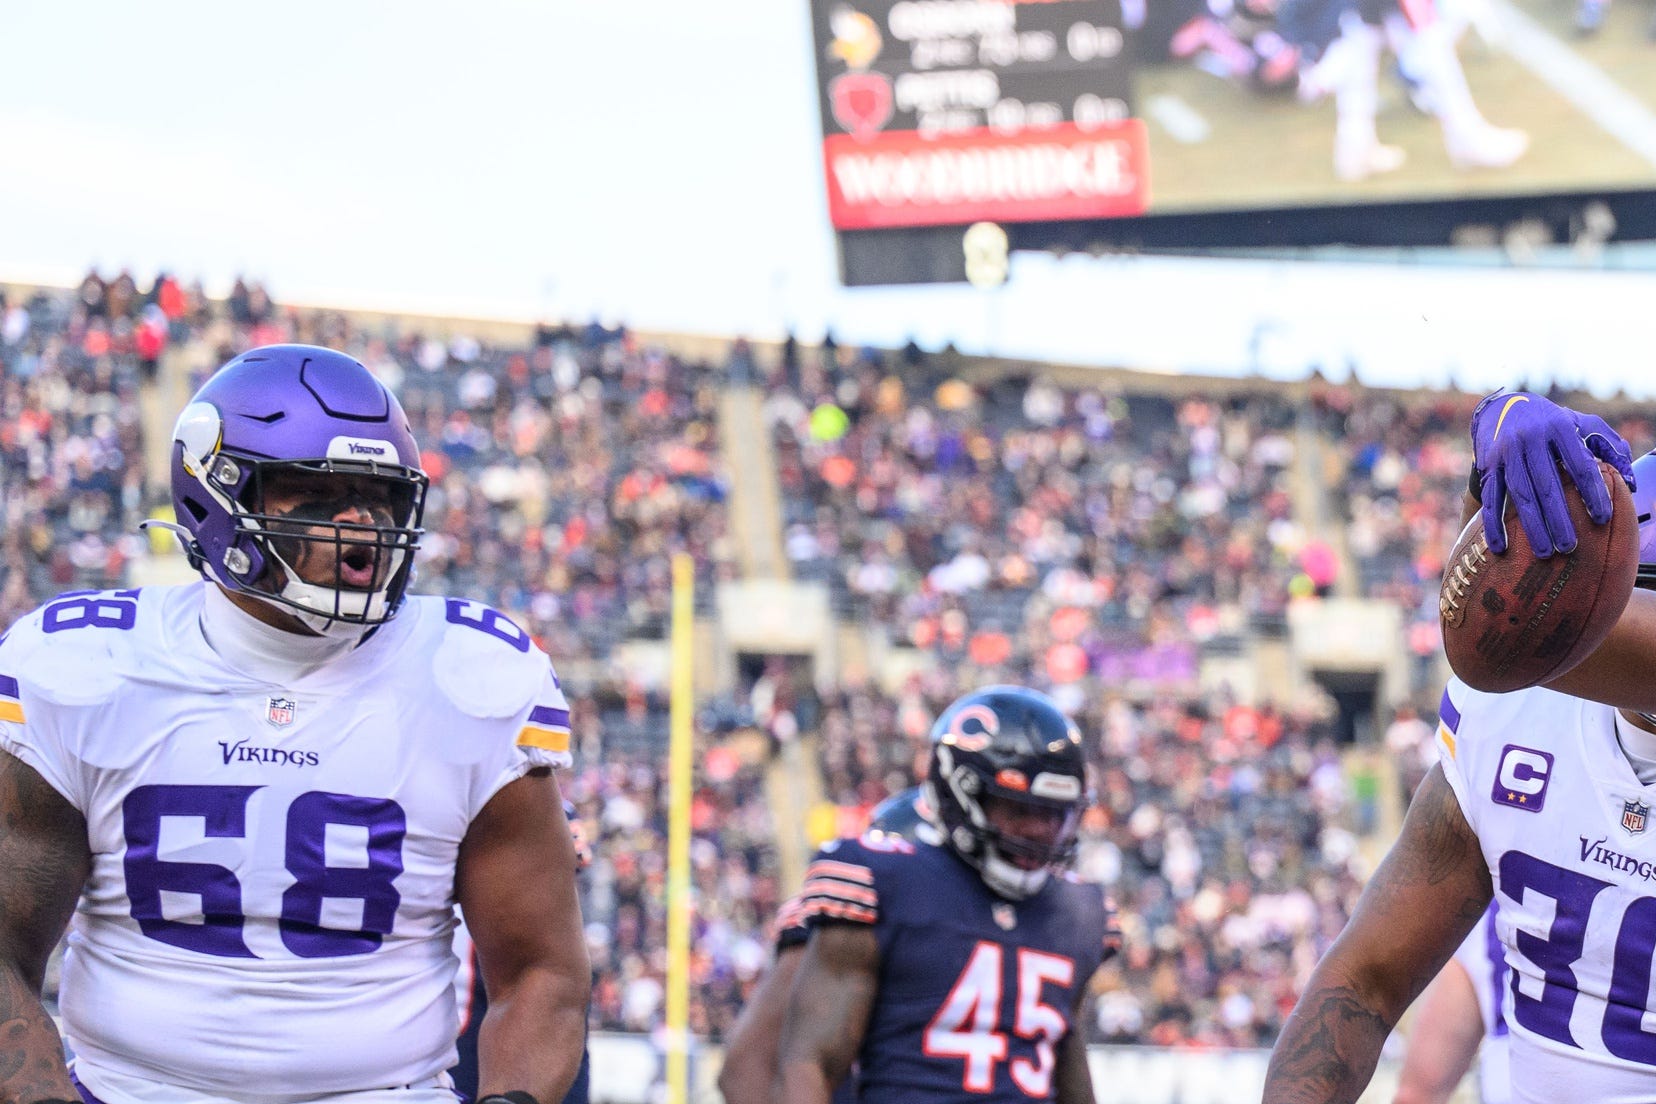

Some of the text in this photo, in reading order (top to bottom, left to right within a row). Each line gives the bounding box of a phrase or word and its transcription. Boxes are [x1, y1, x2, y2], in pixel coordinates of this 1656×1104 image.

[218, 737, 319, 768] VIKINGS
[1500, 749, 1549, 795] C
[1624, 810, 1644, 830] NFL
[123, 784, 407, 959] 68
[922, 940, 1075, 1098] 45
